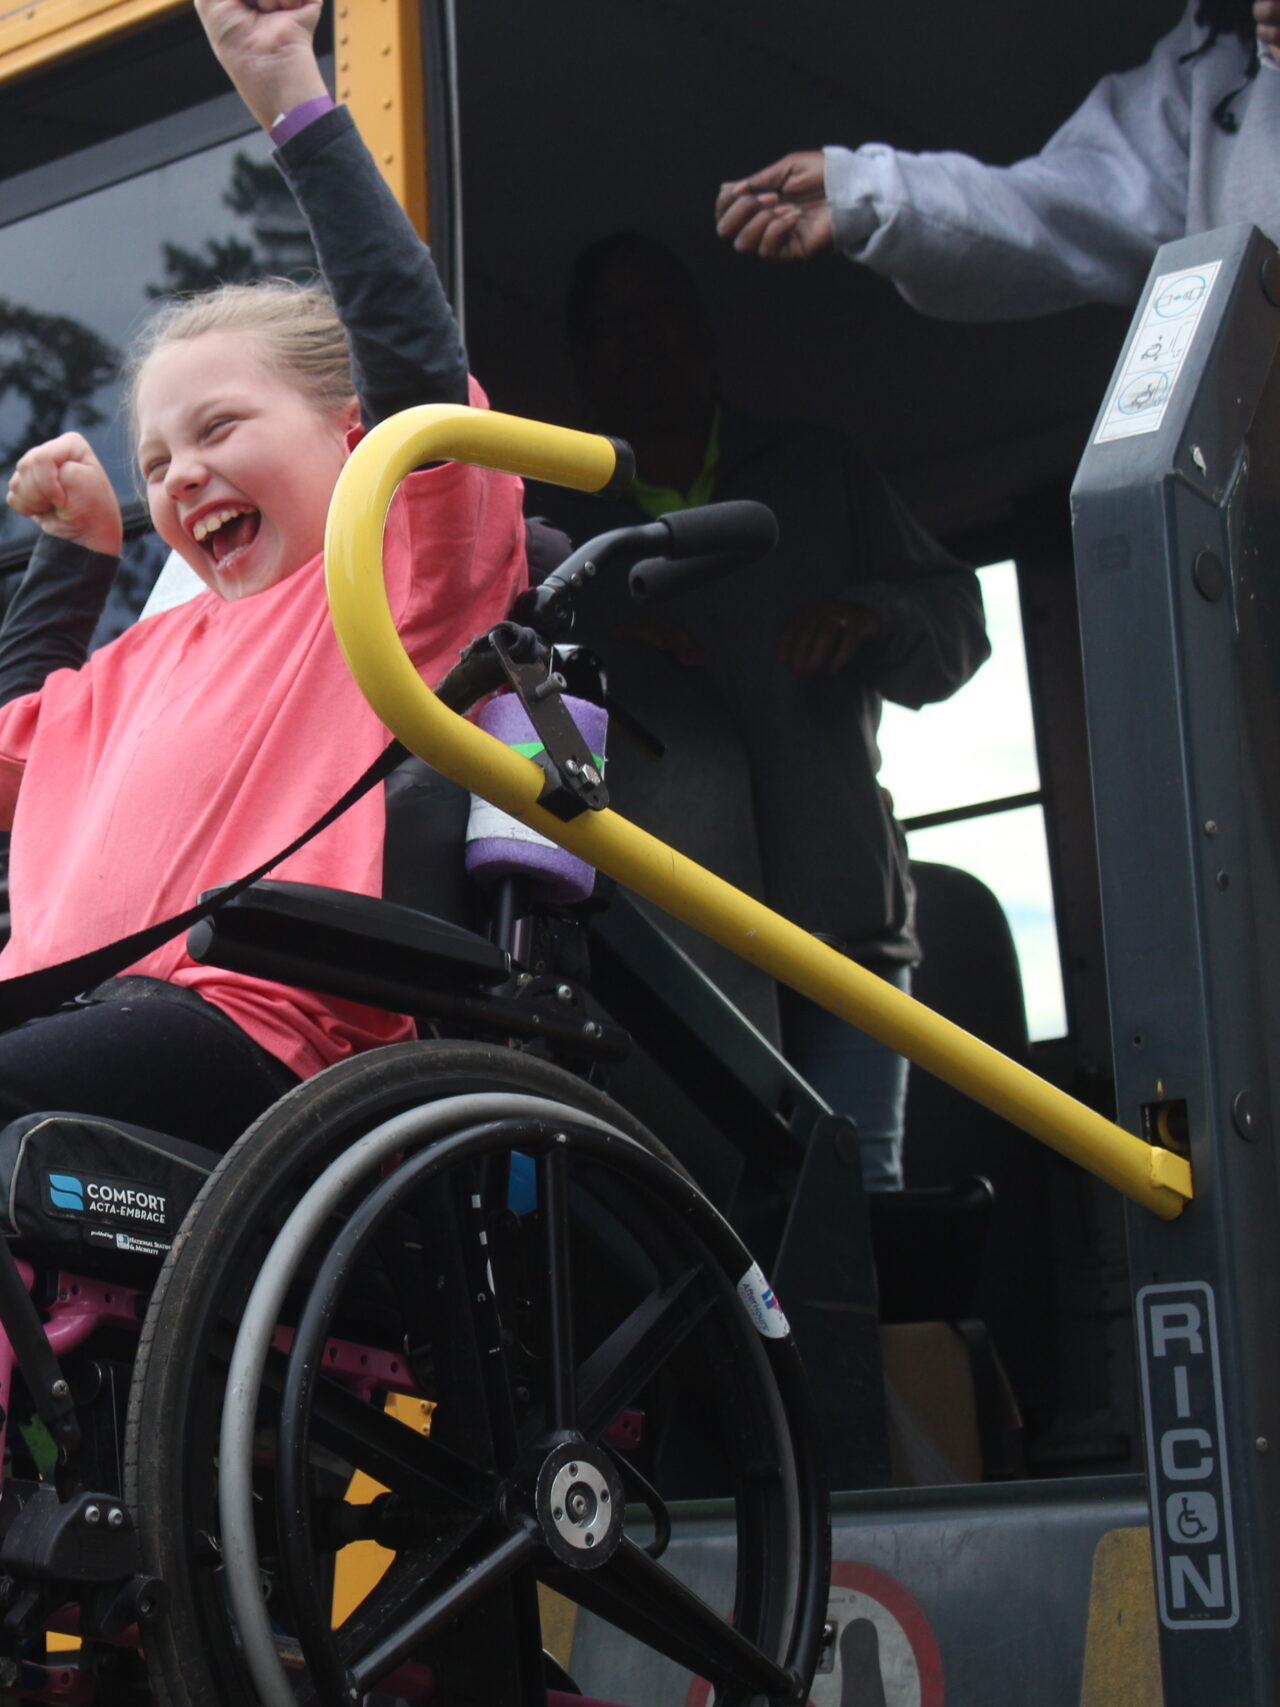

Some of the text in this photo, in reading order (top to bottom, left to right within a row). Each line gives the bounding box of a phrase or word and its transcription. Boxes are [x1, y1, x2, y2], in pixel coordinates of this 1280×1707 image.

[87, 1183, 166, 1212] COMFORT
[89, 1201, 166, 1224] ACTA-EMBRACE
[1149, 1303, 1225, 1609] RICON
